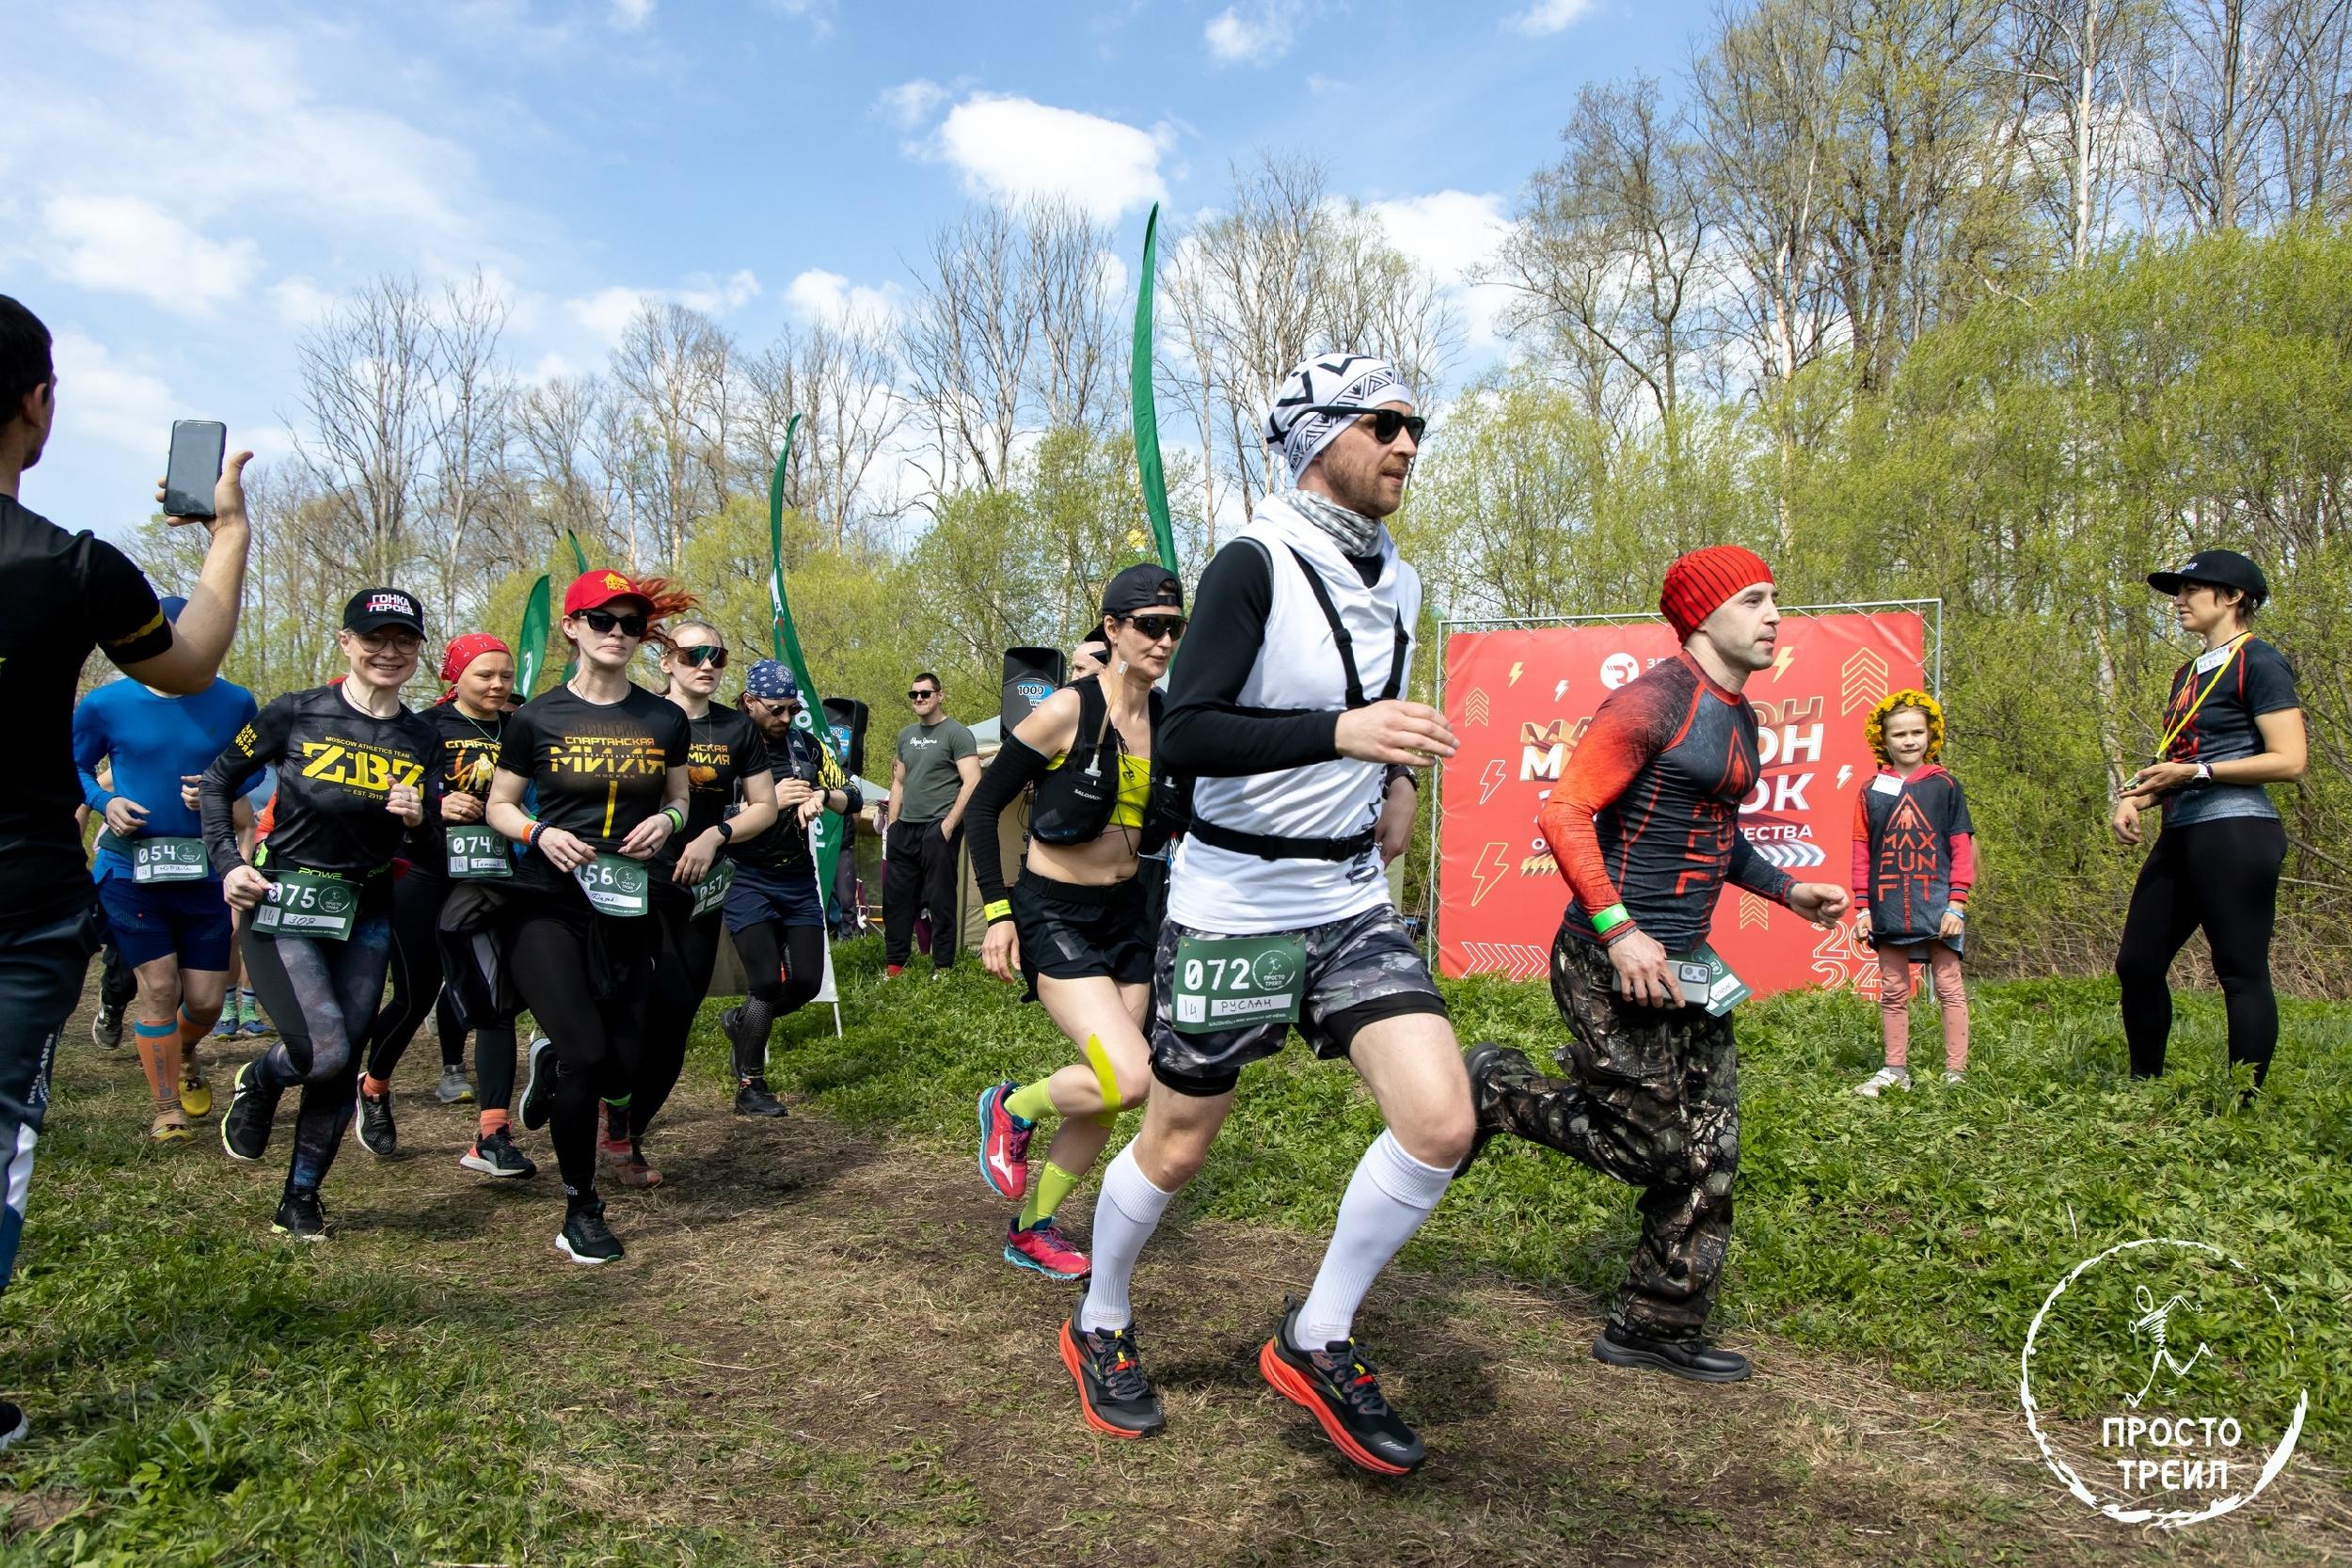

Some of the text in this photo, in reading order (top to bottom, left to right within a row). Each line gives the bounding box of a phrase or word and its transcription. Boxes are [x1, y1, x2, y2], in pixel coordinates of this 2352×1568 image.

[369, 603, 415, 616] ГЕРОЕВ
[372, 594, 411, 607] ГОНКА
[1017, 685, 1044, 695] 1000
[325, 736, 410, 759] MOSCOW ATHLETICS TEAM
[564, 736, 655, 746] СПАРТАНСКАЯ
[549, 745, 666, 776] МИЛЯ
[687, 752, 730, 766] МИЛЯ
[353, 788, 367, 797] EST.
[453, 835, 491, 854] 074
[1882, 832, 1937, 850] MAX
[138, 845, 176, 863] 054
[1879, 851, 1936, 873] FUN
[454, 857, 464, 871] 14
[699, 873, 723, 901] 057
[1878, 873, 1938, 903] FIT
[263, 909, 275, 924] 14
[1184, 958, 1250, 990] 072
[1184, 1000, 1198, 1019] 14
[1221, 999, 1272, 1013] РУСЛАН
